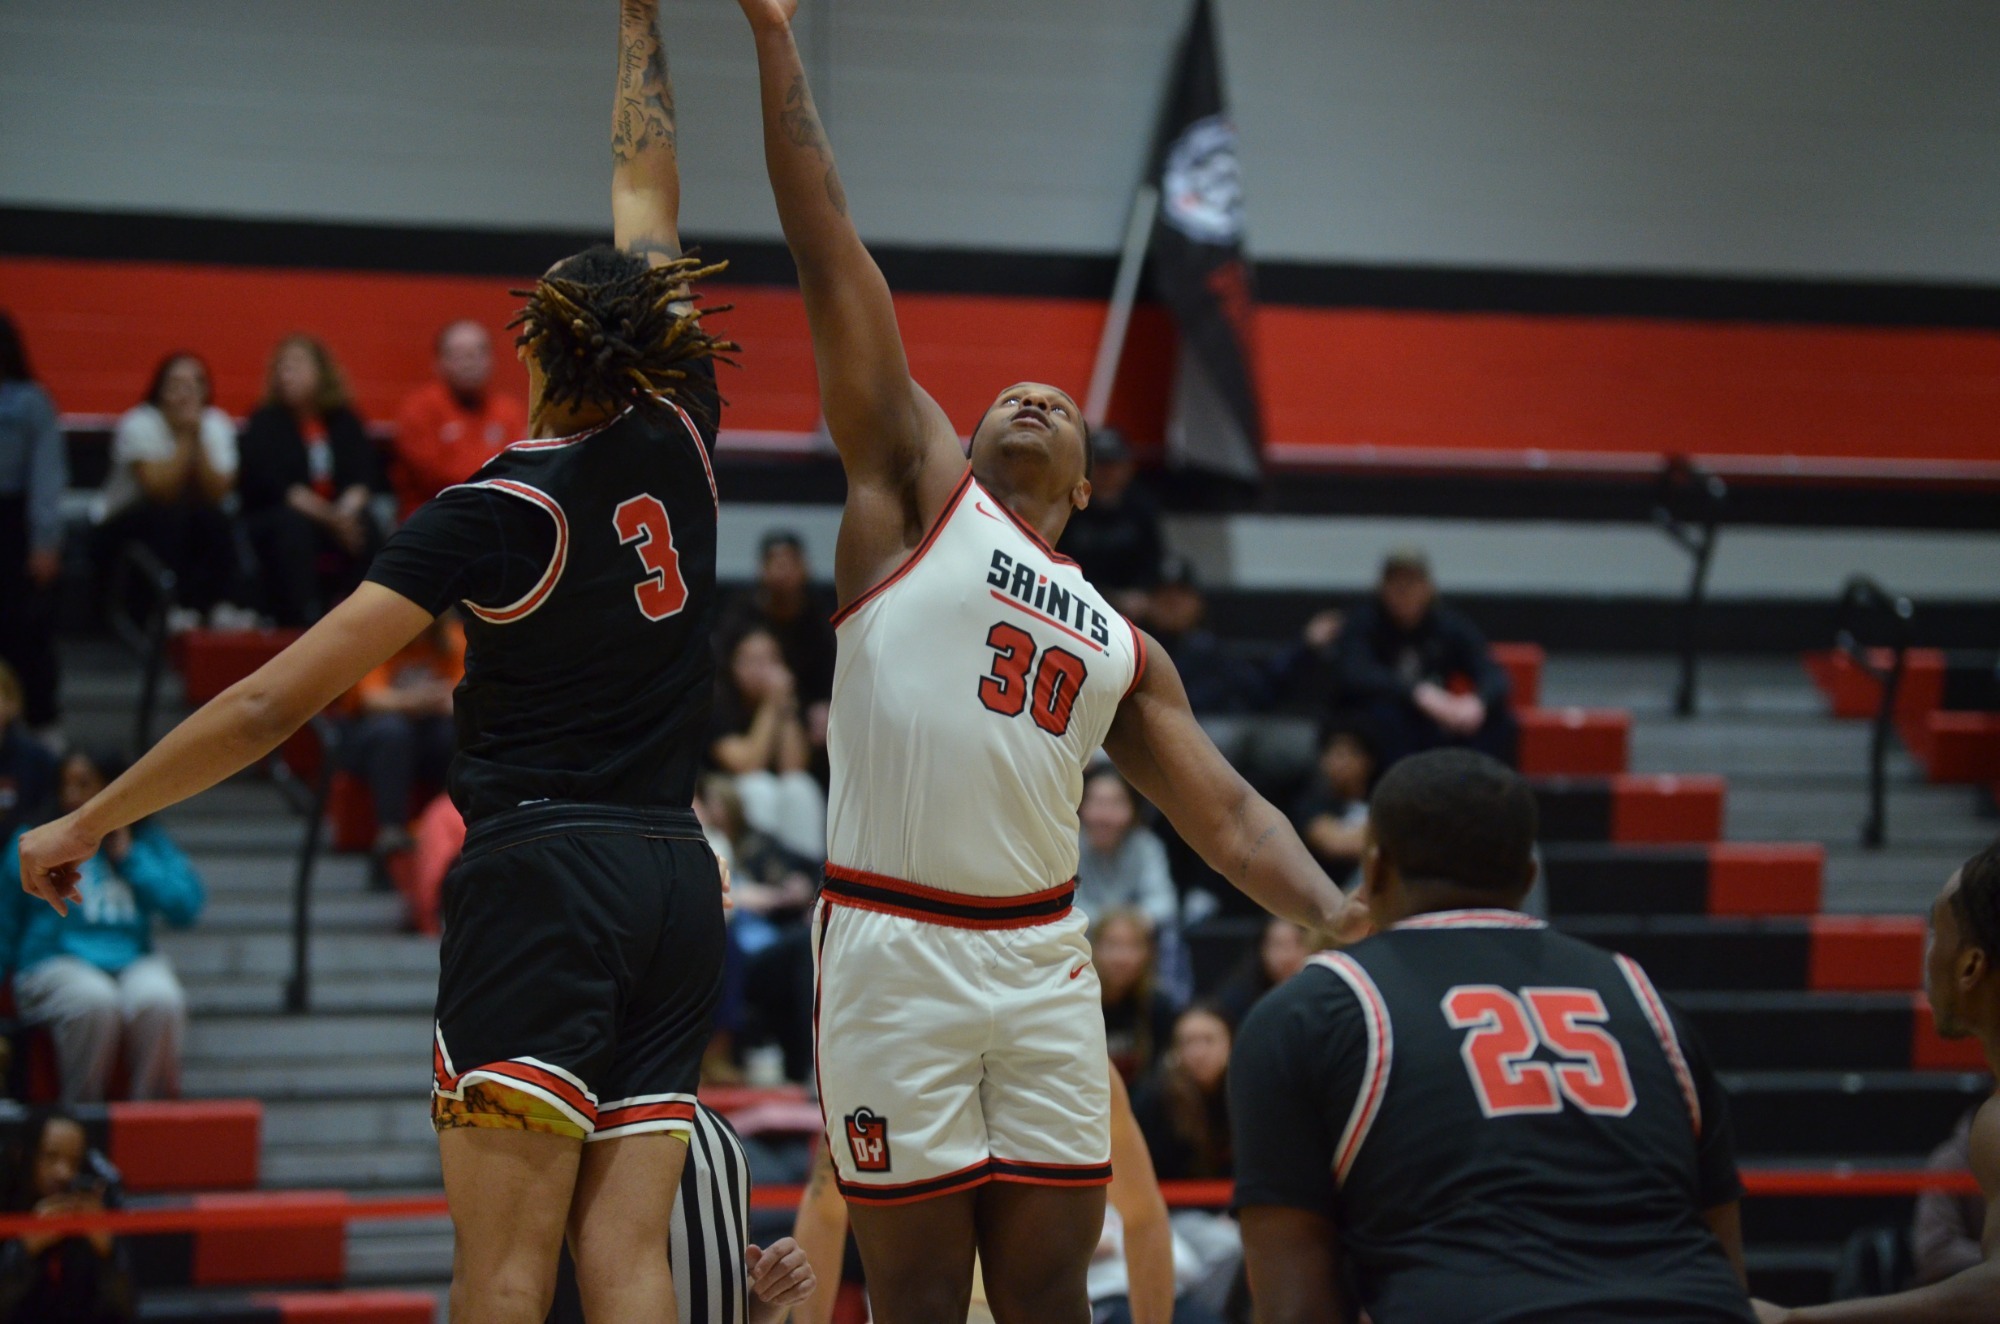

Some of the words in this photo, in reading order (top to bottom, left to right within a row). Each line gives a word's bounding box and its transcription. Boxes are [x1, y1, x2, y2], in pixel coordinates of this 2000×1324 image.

[612, 492, 689, 622] 3
[977, 620, 1088, 737] 30
[1440, 984, 1638, 1119] 25
